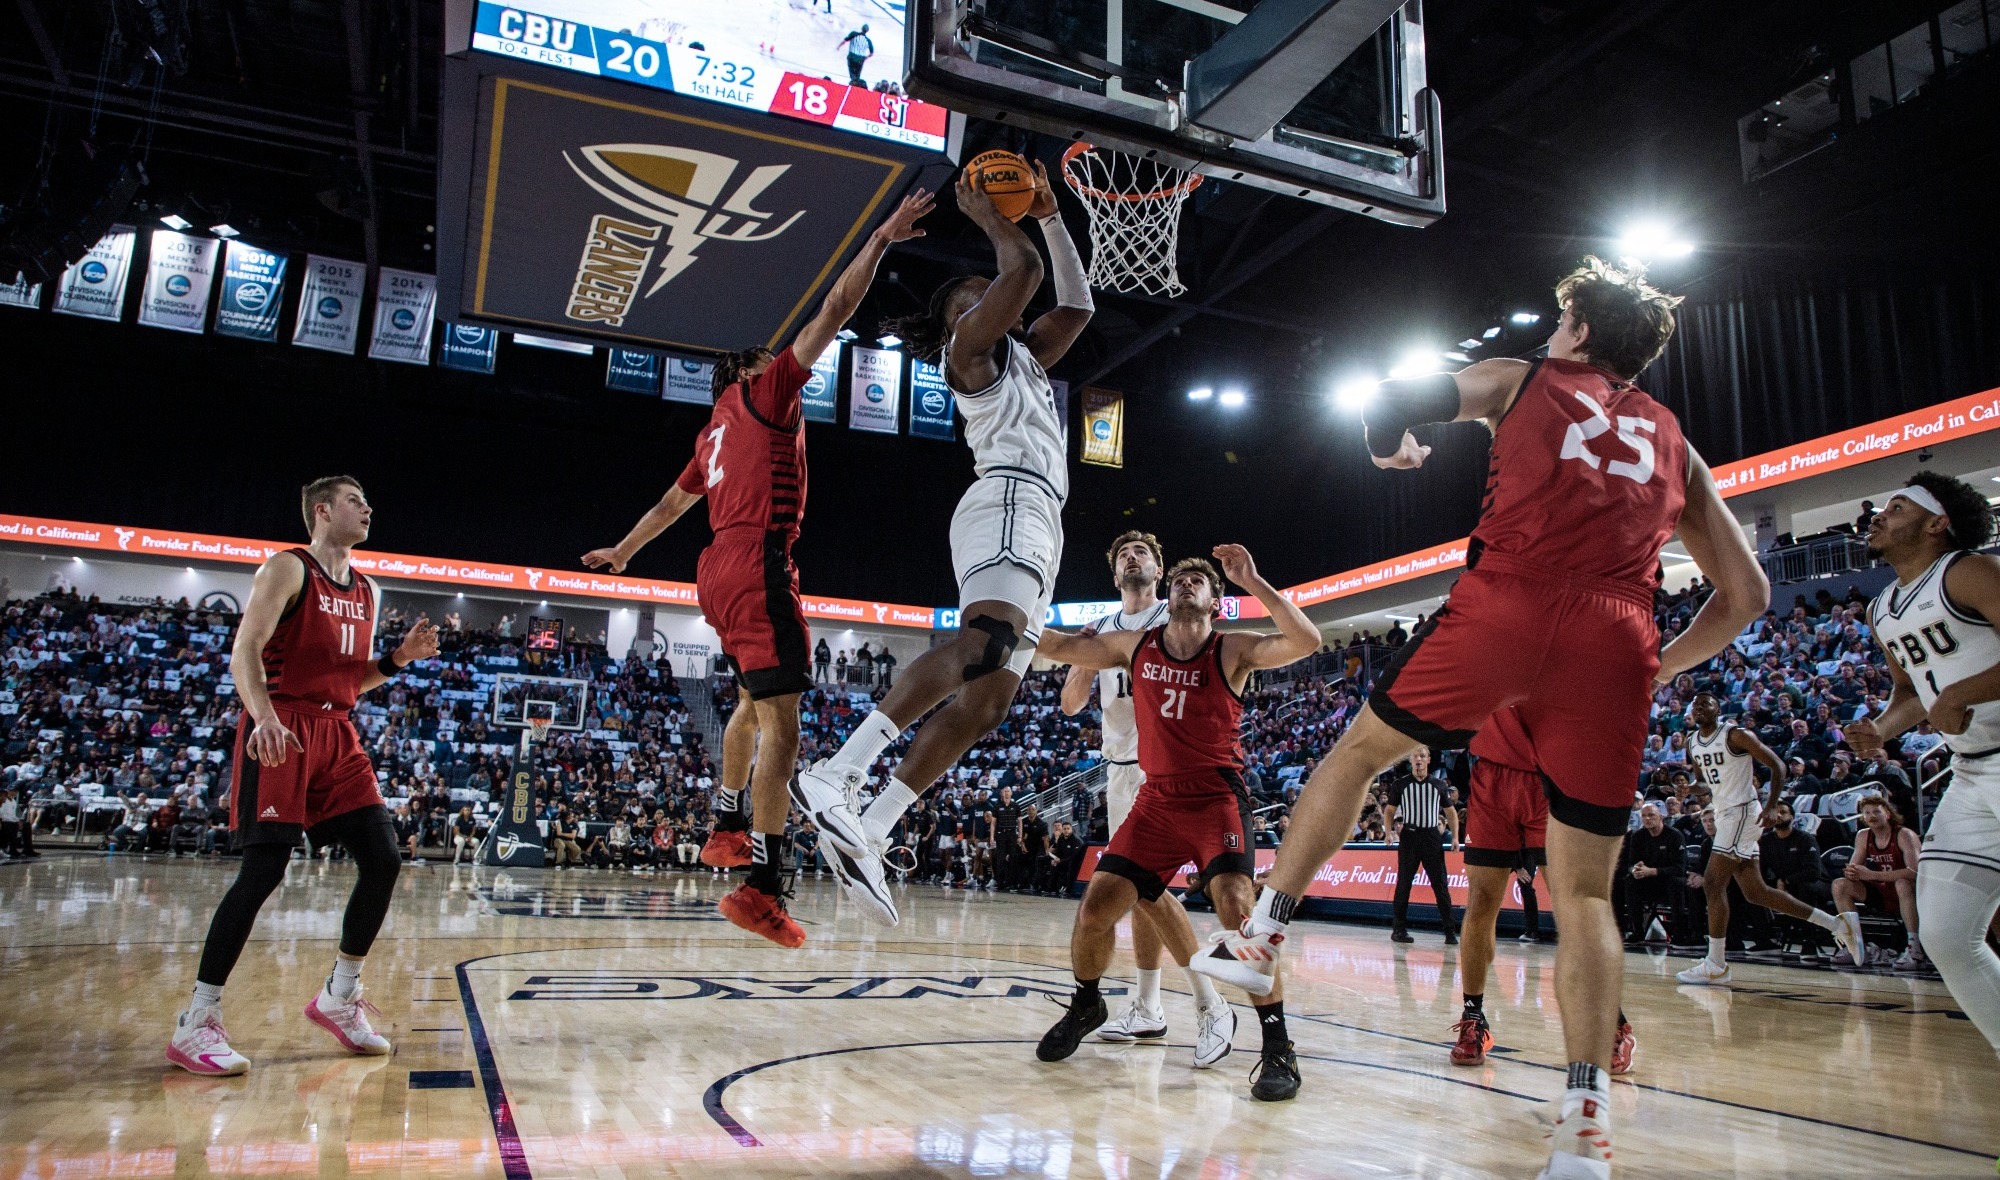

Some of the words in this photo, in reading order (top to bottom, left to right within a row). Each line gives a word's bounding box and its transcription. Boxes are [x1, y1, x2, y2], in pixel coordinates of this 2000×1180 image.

[499, 8, 577, 52] CBU
[606, 38, 660, 78] 20
[695, 55, 756, 89] 7:32
[692, 81, 711, 95] 1st
[715, 84, 755, 104] HALF
[788, 81, 829, 116] 18
[983, 171, 1020, 183] NCAA
[168, 241, 203, 255] 2016
[168, 255, 196, 264] MEN'S
[238, 249, 276, 267] 2016
[152, 261, 210, 275] BASKETBALL
[240, 263, 270, 275] MEN'S
[319, 264, 352, 278] 2015
[565, 213, 663, 328] LANCERS
[320, 278, 347, 287] MEN'S
[391, 277, 424, 290] 2014
[69, 285, 105, 296] DIVISION
[307, 284, 360, 298] BASKETBALL
[392, 290, 419, 299] MEN'S
[145, 303, 203, 318] TOURNAMENT
[154, 298, 190, 309] DIVISION
[303, 319, 343, 331] DIVISION
[863, 355, 889, 367] 2016
[610, 366, 658, 379] CHAMPIONS
[859, 366, 892, 376] WOMEN'S
[917, 373, 945, 383] WOMEN
[687, 376, 711, 385] REGION
[855, 373, 897, 384] BASKETBALL
[913, 379, 949, 391] BASKETBA
[801, 398, 834, 408] AMPIONS
[858, 404, 886, 413] DIVISION
[853, 410, 897, 421] TOURNAMENT
[912, 415, 954, 426] CHAMPIONS
[1559, 390, 1656, 485] 25
[1713, 473, 1736, 491] oted
[1740, 468, 1756, 482] #1
[1760, 461, 1787, 479] Best
[1790, 448, 1840, 471] Private
[1843, 431, 1900, 456] College
[1903, 415, 1945, 441] Food
[1947, 413, 1966, 429] in
[0, 523, 20, 534] ood
[22, 524, 33, 535] in
[36, 525, 101, 542] California!
[142, 535, 189, 551] Provider
[192, 541, 221, 554] Food
[222, 544, 261, 558] Service
[378, 559, 418, 574] College
[419, 562, 446, 576] Food
[447, 566, 458, 577] in
[460, 567, 514, 583] California!
[549, 576, 589, 591] Provider
[591, 579, 616, 592] Food
[617, 582, 650, 595] Service
[652, 586, 678, 599] Voted
[679, 589, 692, 599] #1
[808, 602, 816, 611] in
[817, 603, 864, 617] California!
[893, 610, 928, 623] Provider
[1297, 589, 1322, 602] Provider
[1322, 585, 1339, 595] Food
[1340, 578, 1363, 591] Service
[1363, 572, 1383, 584] Voted
[1383, 568, 1393, 578] #1
[1394, 563, 1410, 575] Best
[1411, 557, 1438, 571] Private
[318, 593, 364, 620] SEATTLE
[1077, 604, 1106, 614] 7:32
[340, 623, 355, 656] 11
[673, 642, 711, 651] EQUIPPED
[1886, 619, 1960, 670] CBU
[684, 649, 709, 657] SERVE
[1141, 662, 1200, 687] SEATTLE
[1160, 688, 1187, 720] 21
[1694, 751, 1725, 768] CBU
[1705, 768, 1721, 785] 12
[512, 772, 530, 824] CBU
[1313, 864, 1348, 886] ollege
[1349, 865, 1382, 884] Food
[1384, 867, 1398, 884] in
